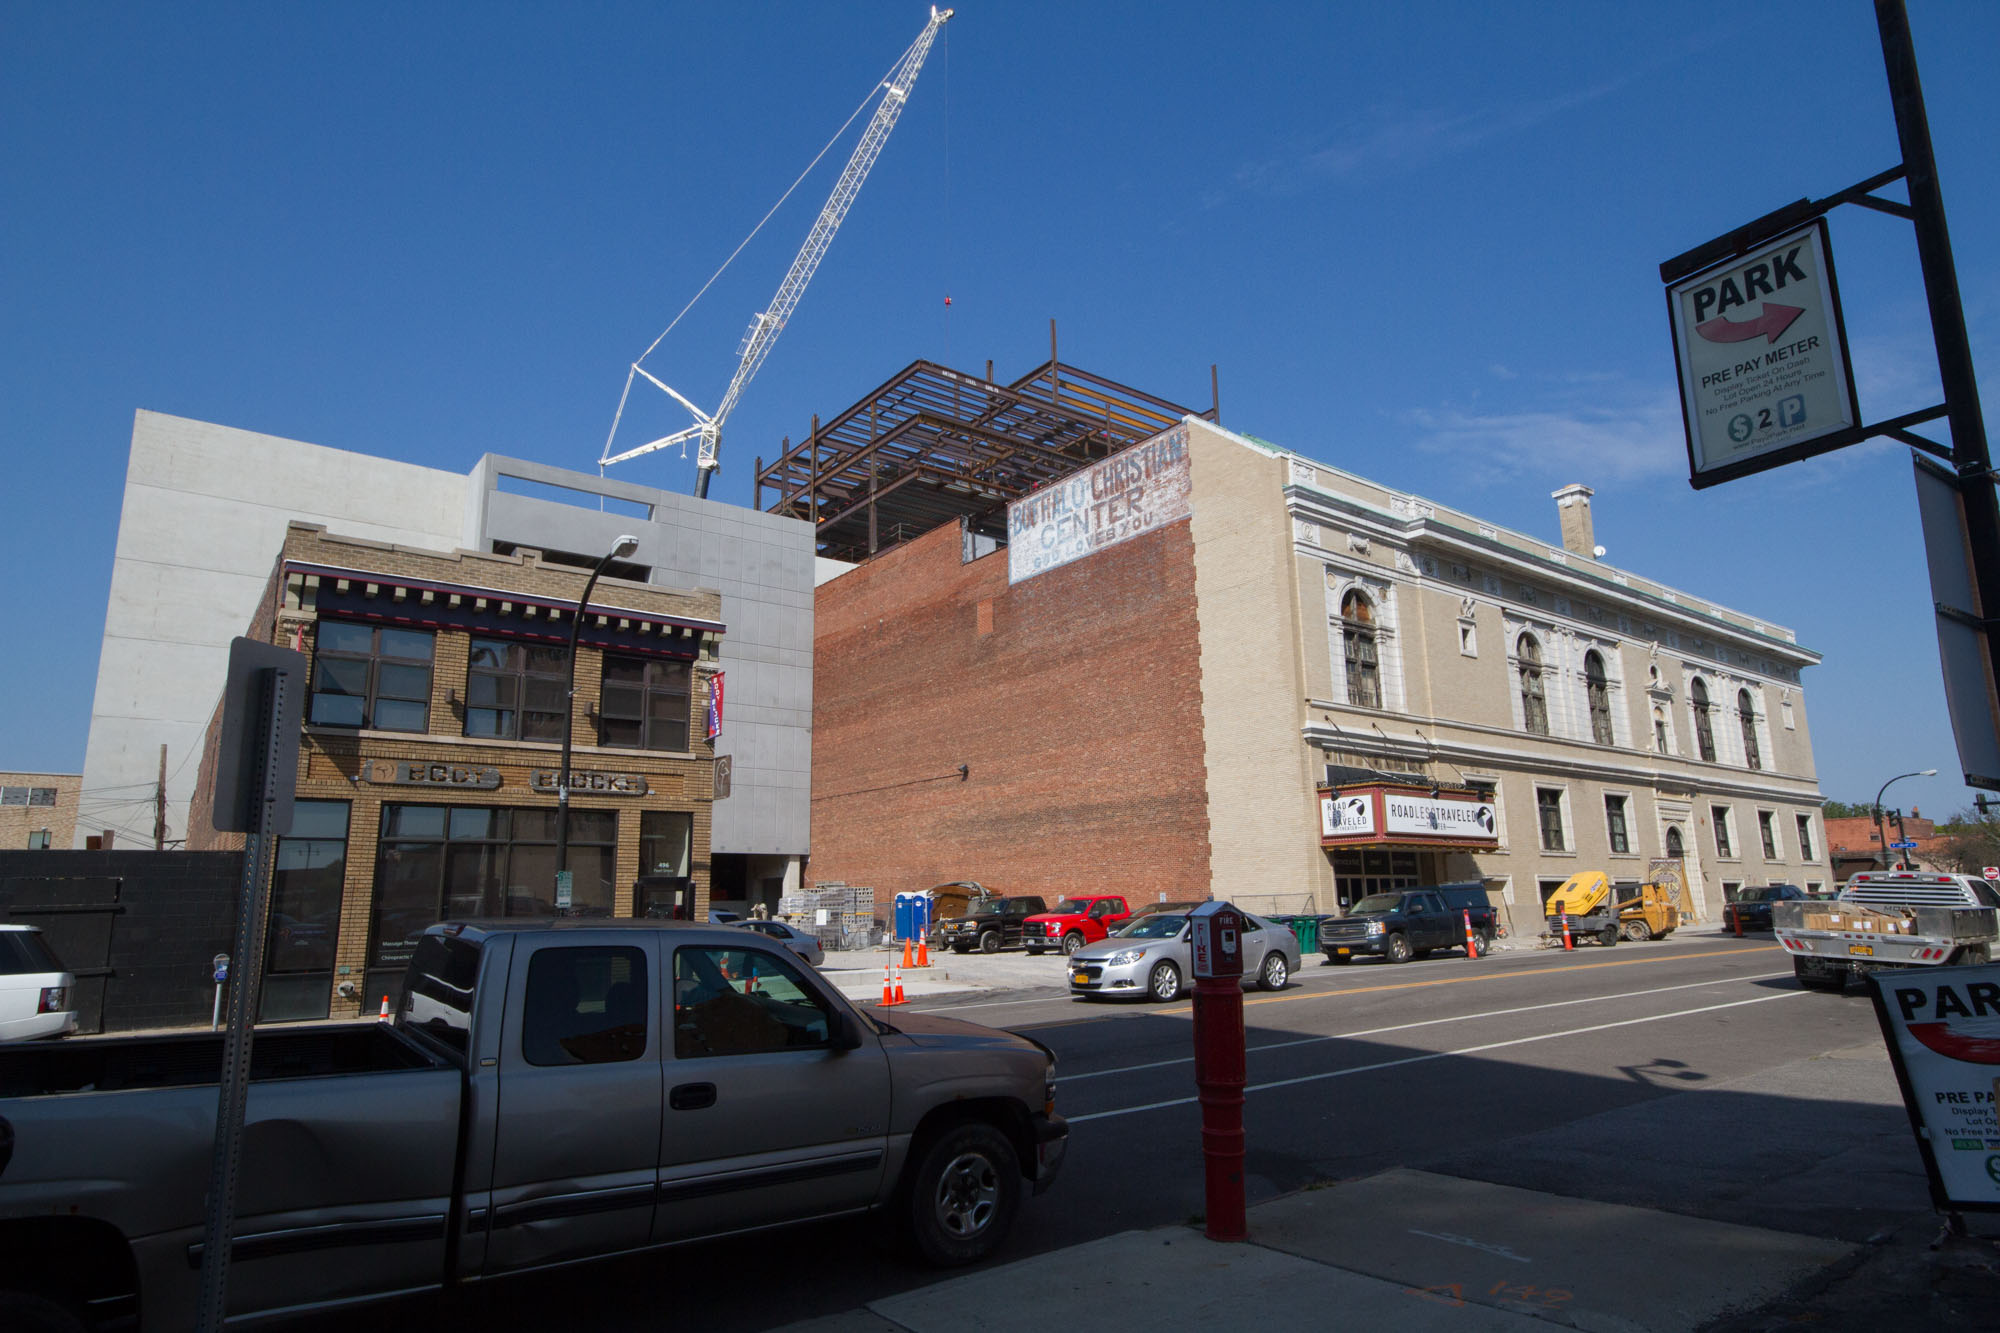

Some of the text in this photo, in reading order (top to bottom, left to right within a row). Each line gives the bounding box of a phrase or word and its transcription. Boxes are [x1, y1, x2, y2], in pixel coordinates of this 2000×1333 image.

[1693, 246, 1807, 323] PARK
[1702, 335, 1820, 389] PRE PAY METER
[1714, 356, 1810, 396] Display Ticket On Dash
[1724, 369, 1802, 401] Lot Open 24 Hours
[1706, 370, 1826, 416] No Free Parking At Any Time
[1758, 408, 1773, 429] 2
[1013, 431, 1183, 537] BUFFALO CHRISTIAN
[1041, 487, 1145, 550] CENTER
[1120, 511, 1154, 537] YOU
[1327, 801, 1347, 812] ROAD
[1328, 816, 1368, 828] TRAVELED
[1219, 916, 1234, 925] FIRE
[1197, 923, 1207, 962] FIRE
[1935, 1091, 1971, 1104] PRE
[1951, 1107, 1989, 1117] Display
[1965, 1117, 1983, 1126] Lot
[1944, 1128, 1959, 1136] No
[1960, 1128, 1983, 1137] Free
